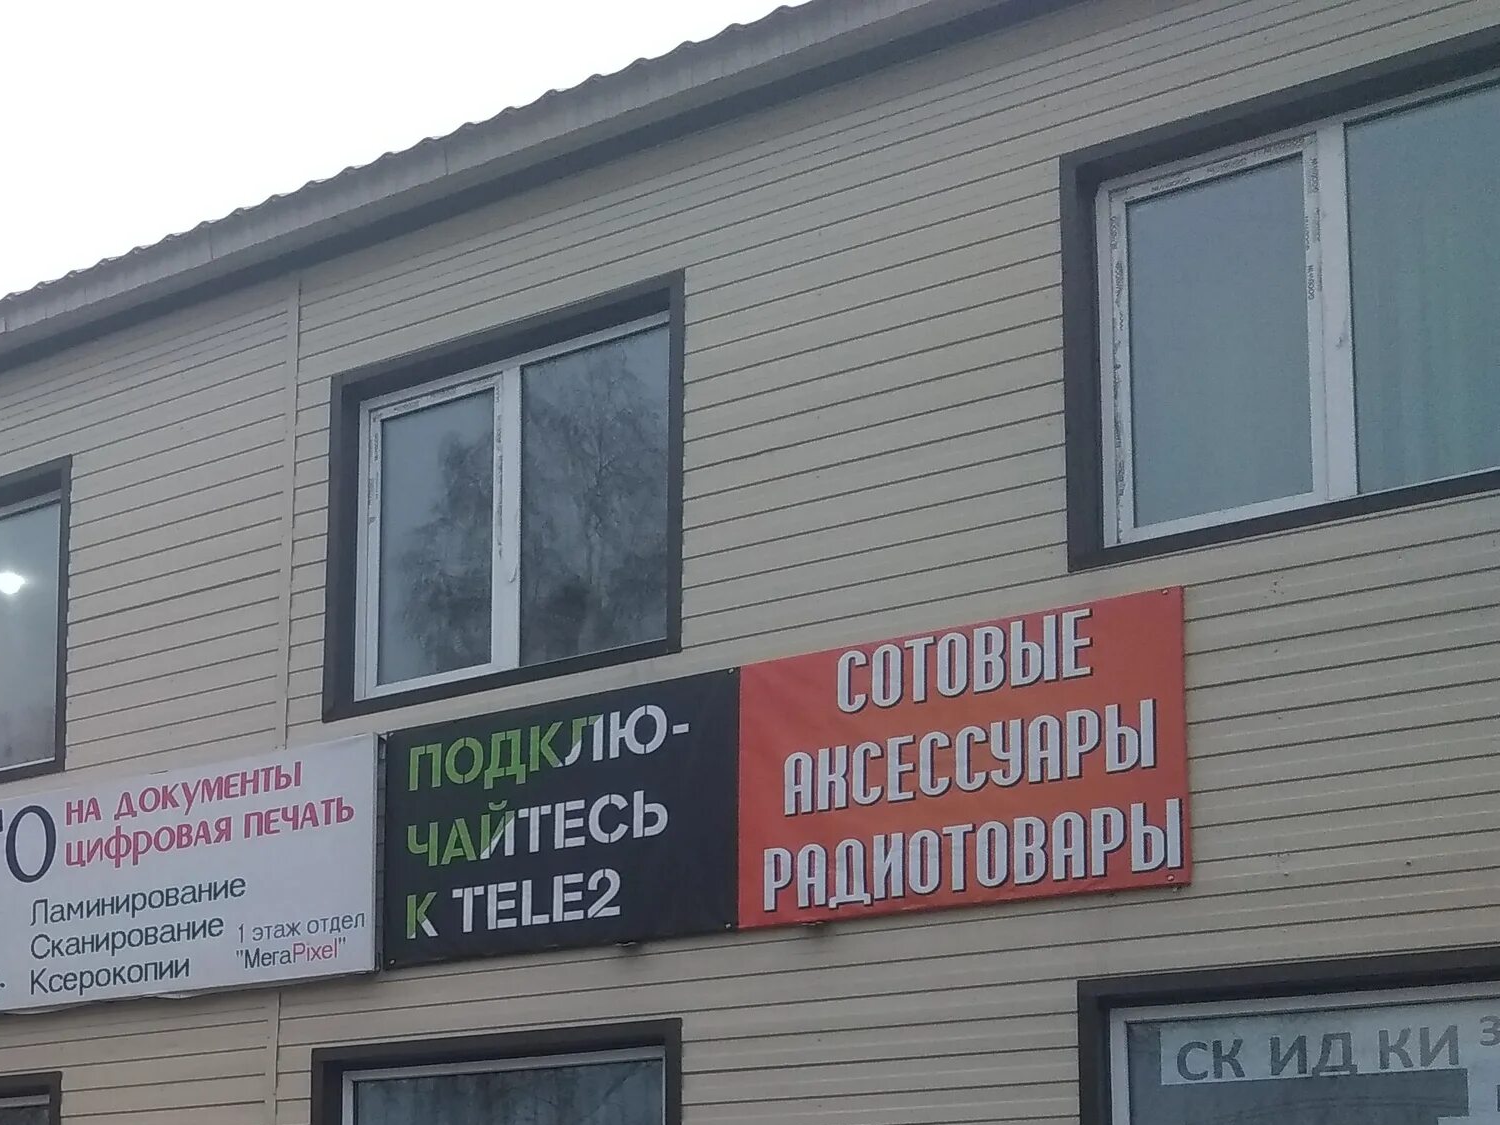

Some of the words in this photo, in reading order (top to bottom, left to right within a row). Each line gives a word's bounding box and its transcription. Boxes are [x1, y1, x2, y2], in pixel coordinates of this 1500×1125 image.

[837, 608, 1093, 714] СОТОВЫЕ
[408, 704, 690, 791] ПОДКЛЮ-
[783, 699, 1156, 816] АКСЕССУАРЫ
[66, 797, 102, 826] НА
[114, 761, 302, 820] ДОКУМЕНТЫ
[407, 790, 669, 867] ЧАЙТЕСЬ
[65, 816, 233, 868] ЦИФРОВАЯ
[243, 796, 355, 839] ПЕЧАТЬ
[763, 797, 1184, 912] РАДИОТОВАРЫ
[29, 875, 246, 927] Ламинирование
[238, 923, 245, 943] 1
[252, 921, 302, 941] этаж
[306, 912, 365, 934] отдел
[406, 891, 439, 940] К
[451, 868, 622, 933] TELE2
[29, 915, 225, 960] Сканирование
[235, 936, 347, 969] "МегаPixel"
[29, 956, 190, 996] Ксерокопии
